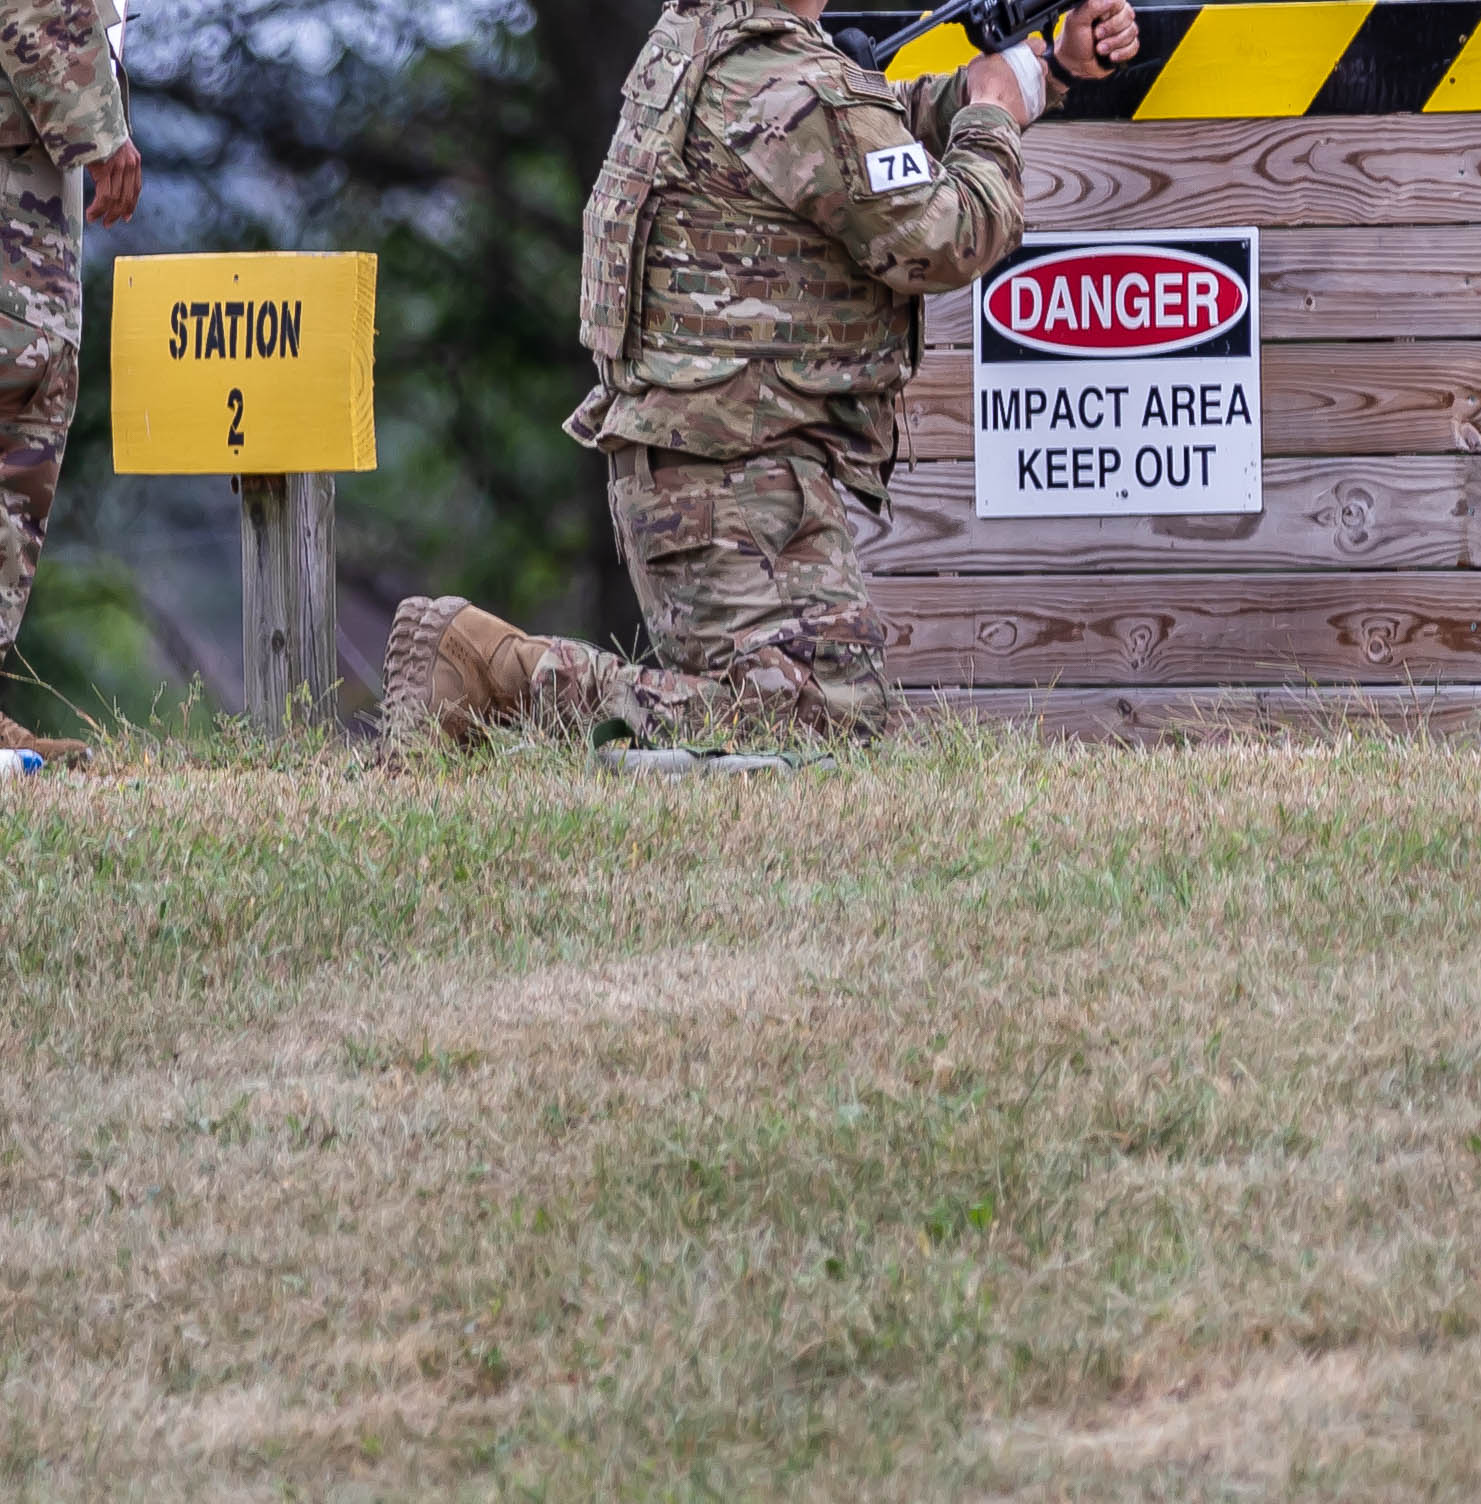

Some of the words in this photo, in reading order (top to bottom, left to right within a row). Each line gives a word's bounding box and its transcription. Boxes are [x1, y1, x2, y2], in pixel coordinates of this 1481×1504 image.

[878, 152, 922, 181] 7A
[1010, 272, 1220, 331] DANGER
[169, 301, 302, 360] STATION
[227, 387, 245, 447] 2
[980, 387, 1129, 431] IMPACT
[1141, 384, 1252, 428] AREA
[1018, 448, 1120, 490] KEEP
[1135, 445, 1216, 487] OUT
